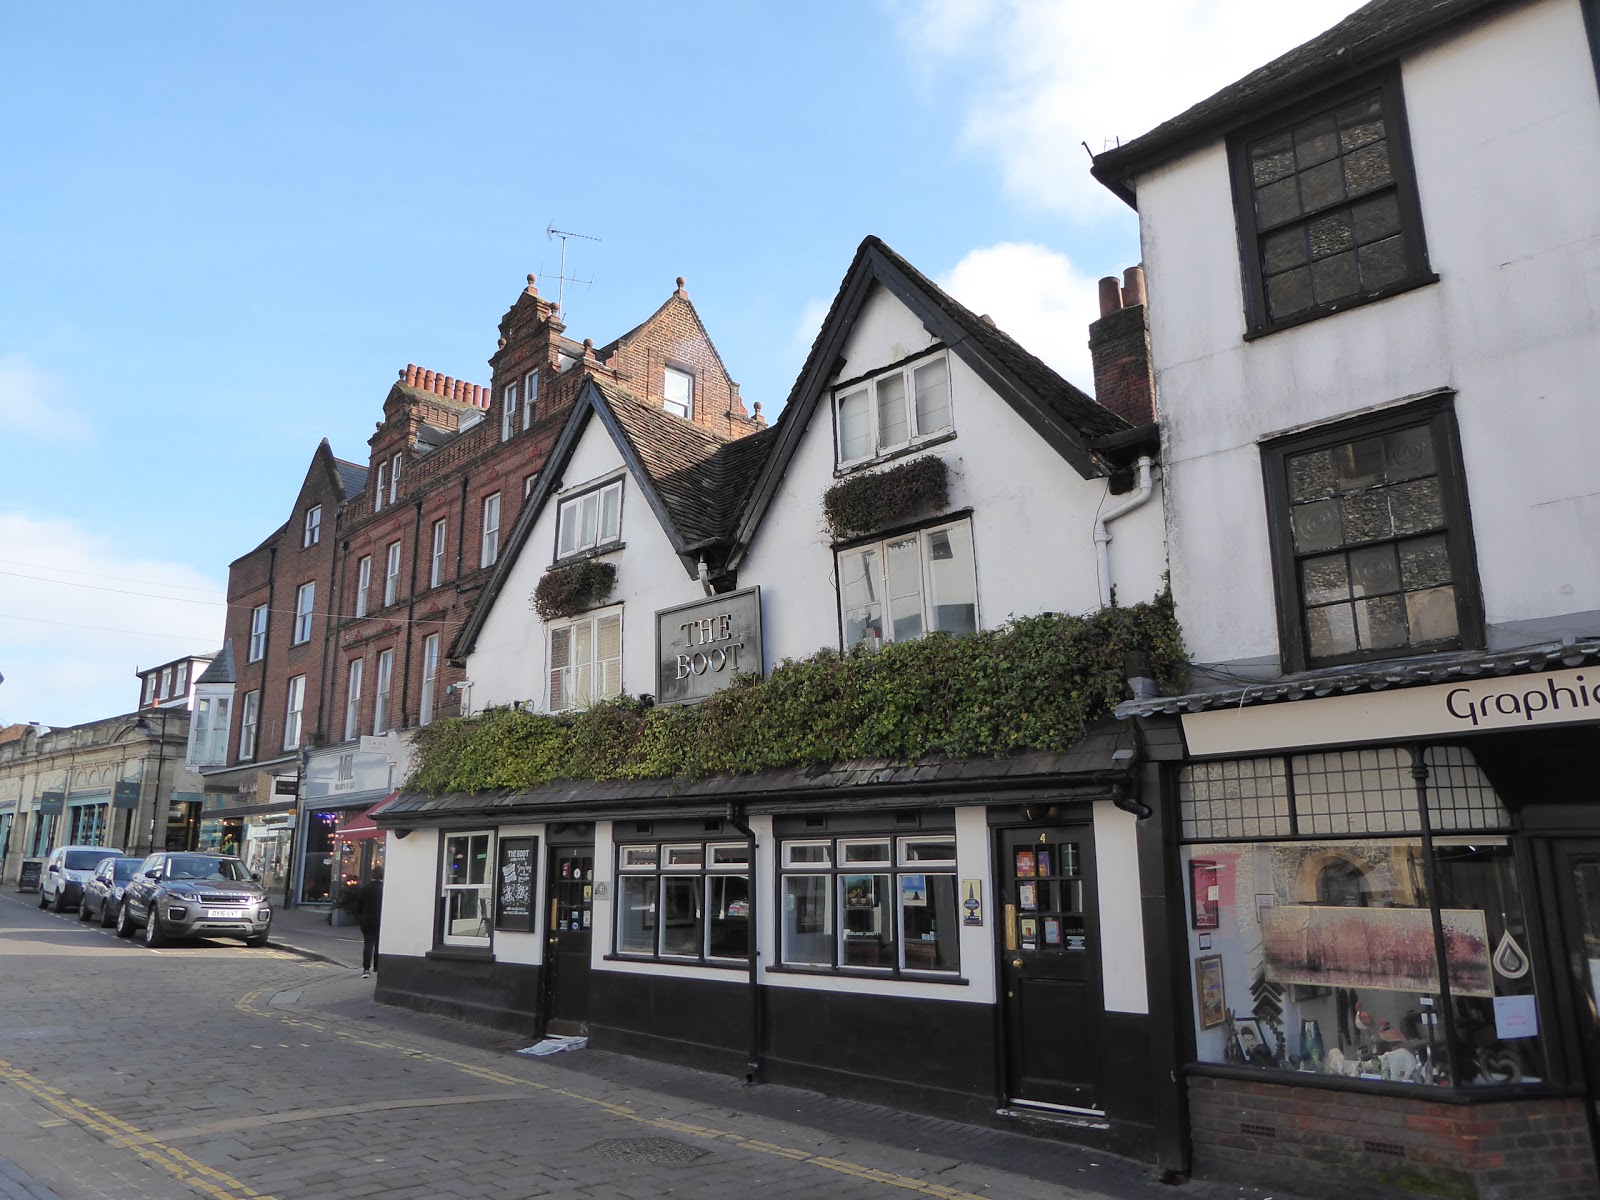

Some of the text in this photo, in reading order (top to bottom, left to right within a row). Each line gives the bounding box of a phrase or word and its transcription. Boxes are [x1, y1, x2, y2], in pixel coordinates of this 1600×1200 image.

[679, 614, 732, 648] THE
[675, 642, 744, 680] BOOT
[1040, 832, 1046, 843] 4
[507, 849, 530, 858] THE BOOT
